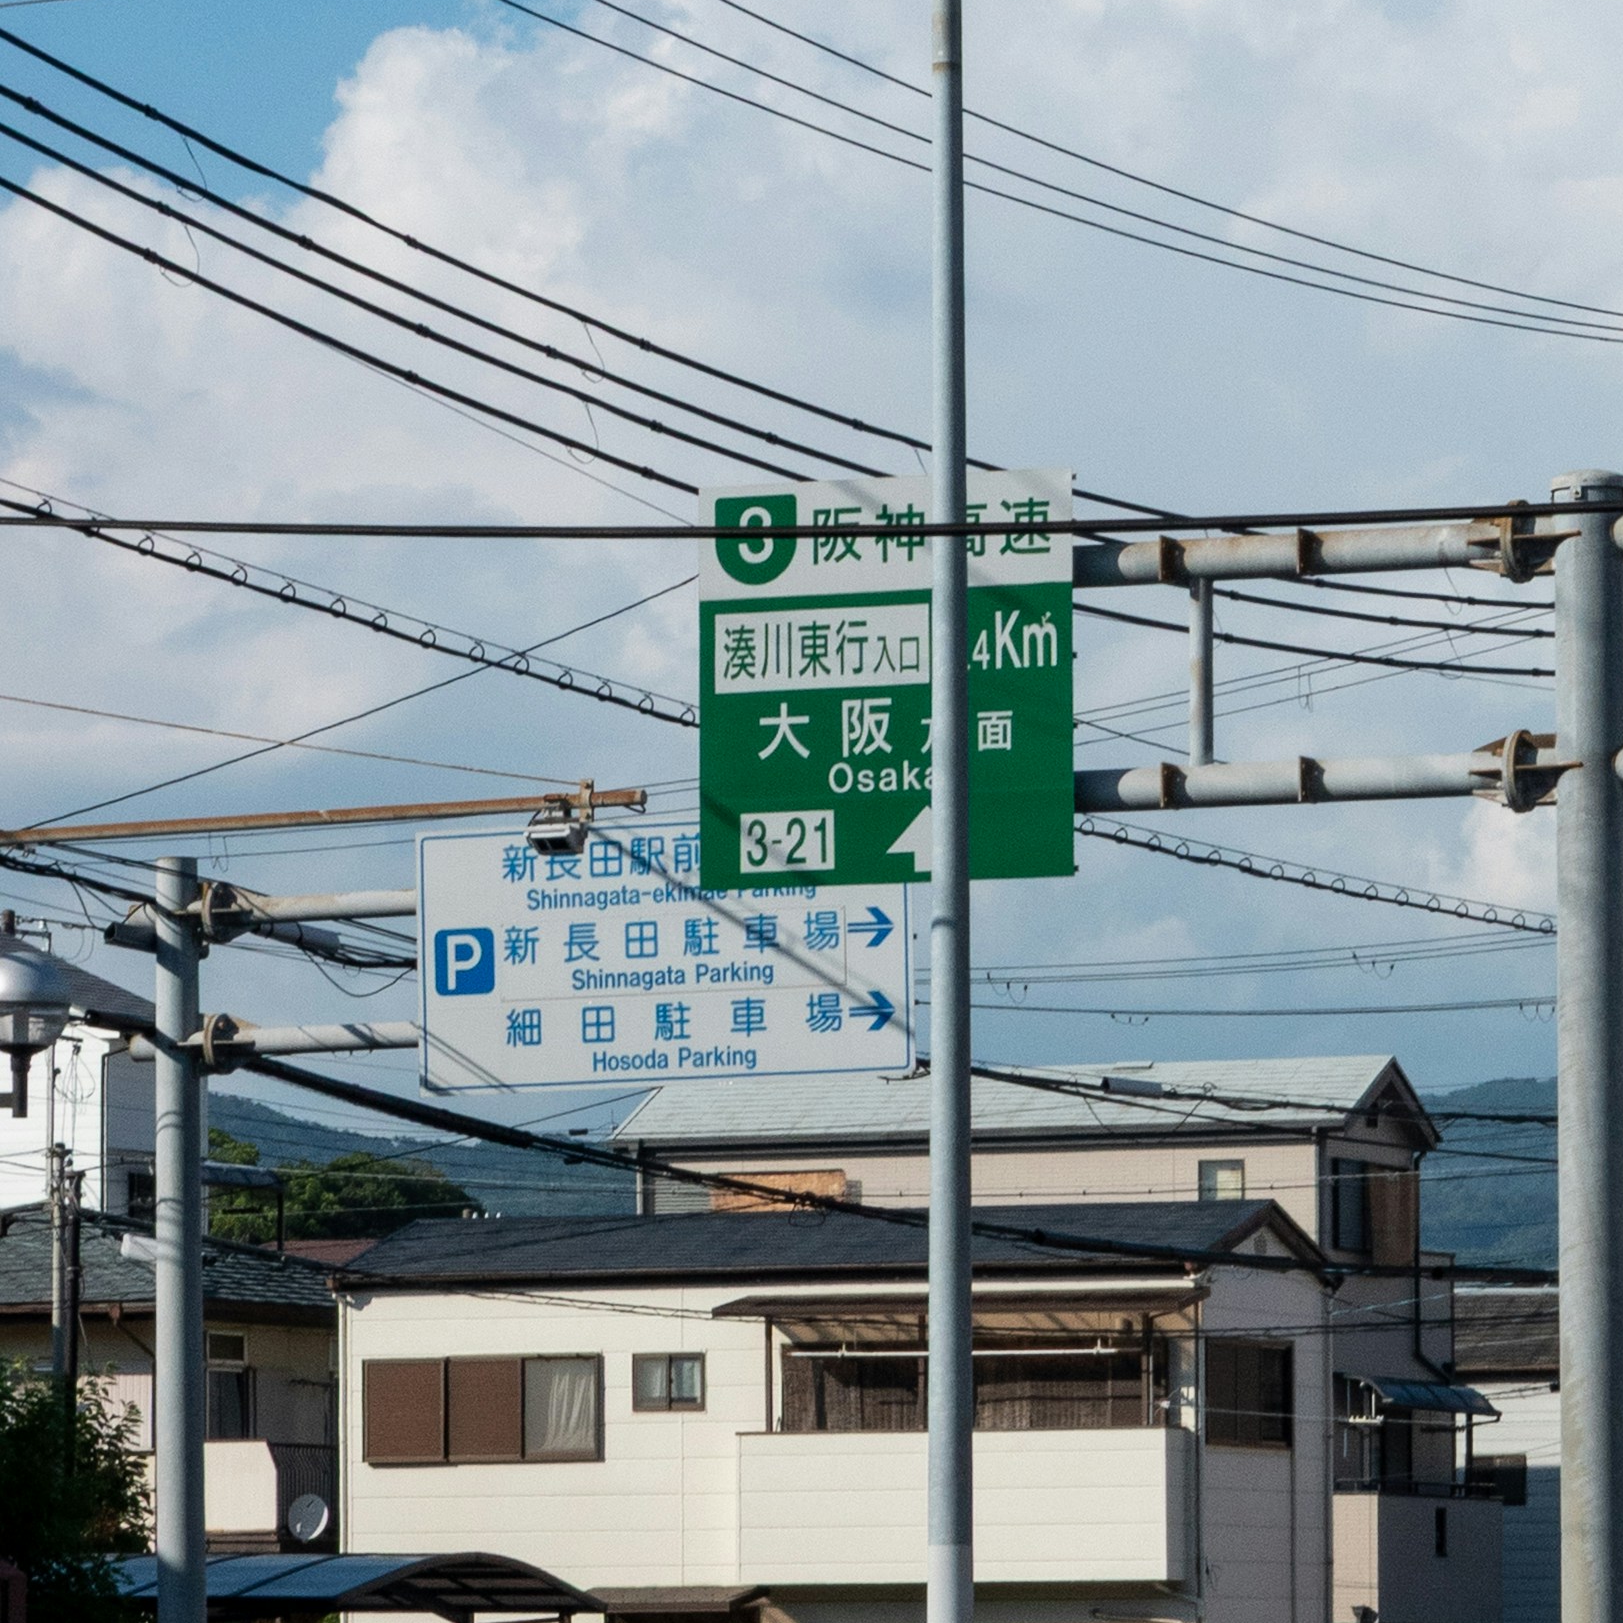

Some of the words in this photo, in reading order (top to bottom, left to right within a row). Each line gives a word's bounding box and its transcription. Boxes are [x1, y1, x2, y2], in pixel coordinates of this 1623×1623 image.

[738, 507, 774, 564] 3
[746, 817, 828, 867] 3-21
[446, 934, 482, 990] P
[504, 911, 840, 965] 新長田駐車場
[572, 967, 685, 991] Shinnagata
[696, 961, 774, 987] Parking
[506, 993, 843, 1048] 細田駐車場
[593, 1049, 669, 1072] Hosoda
[678, 1045, 757, 1069] Parking
